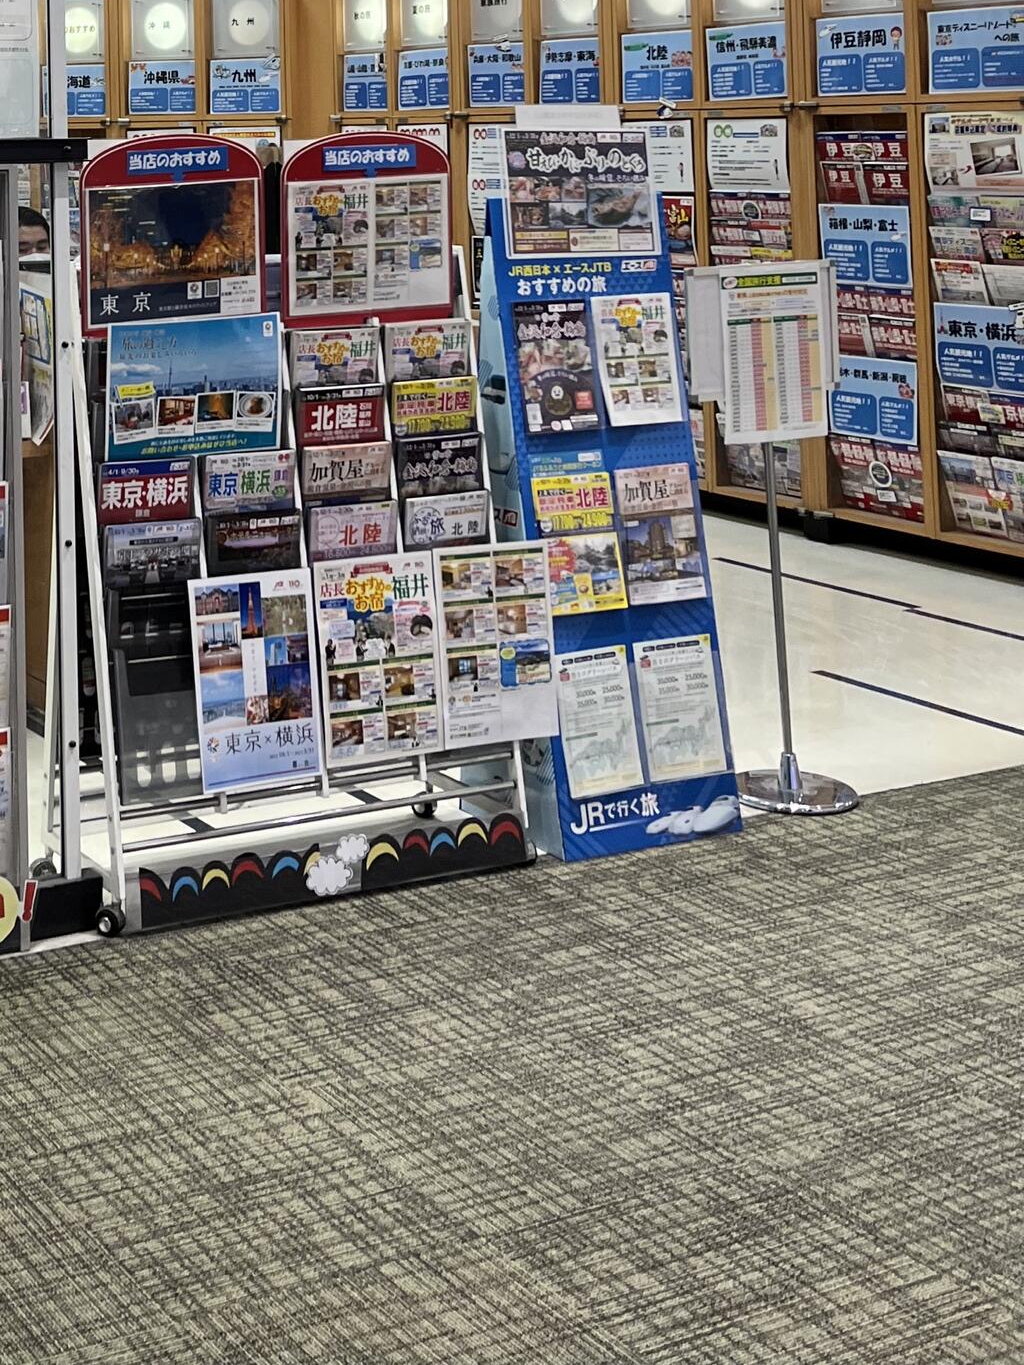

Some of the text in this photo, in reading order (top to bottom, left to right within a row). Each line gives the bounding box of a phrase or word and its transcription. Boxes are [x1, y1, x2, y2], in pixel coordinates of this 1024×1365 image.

[231, 17, 255, 27] 九州
[829, 28, 887, 51] 伊豆静岡
[646, 44, 669, 62] 北陸
[66, 74, 92, 89] 海道
[143, 70, 181, 84] 沖縄県
[231, 68, 257, 83] 九州
[127, 151, 222, 170] 当店のおすすめ
[323, 147, 411, 167] 当店のおすすめ
[829, 169, 851, 183] 伊豆
[872, 172, 904, 189] 伊豆
[343, 192, 369, 210] 福井
[828, 217, 899, 232] 箱根・山梨・富士
[563, 262, 612, 273] エースJTB
[517, 276, 608, 296] おすすめの旅
[98, 290, 152, 317] 東京
[442, 332, 468, 350] 福井
[947, 319, 1018, 343] 東京・横浜
[350, 340, 377, 358] 福井
[438, 391, 470, 412] 北陸
[310, 402, 358, 432] 北陸
[310, 458, 365, 482] 加賀屋
[101, 475, 189, 511] 東京・横浜
[207, 469, 271, 498] 東京 横浜
[624, 480, 671, 503] 加賀屋
[575, 487, 609, 508] 北陸
[338, 523, 382, 547] 北陸
[451, 520, 480, 536] 北陸
[392, 573, 430, 601] 福井
[570, 791, 661, 835] JRで行く旅
